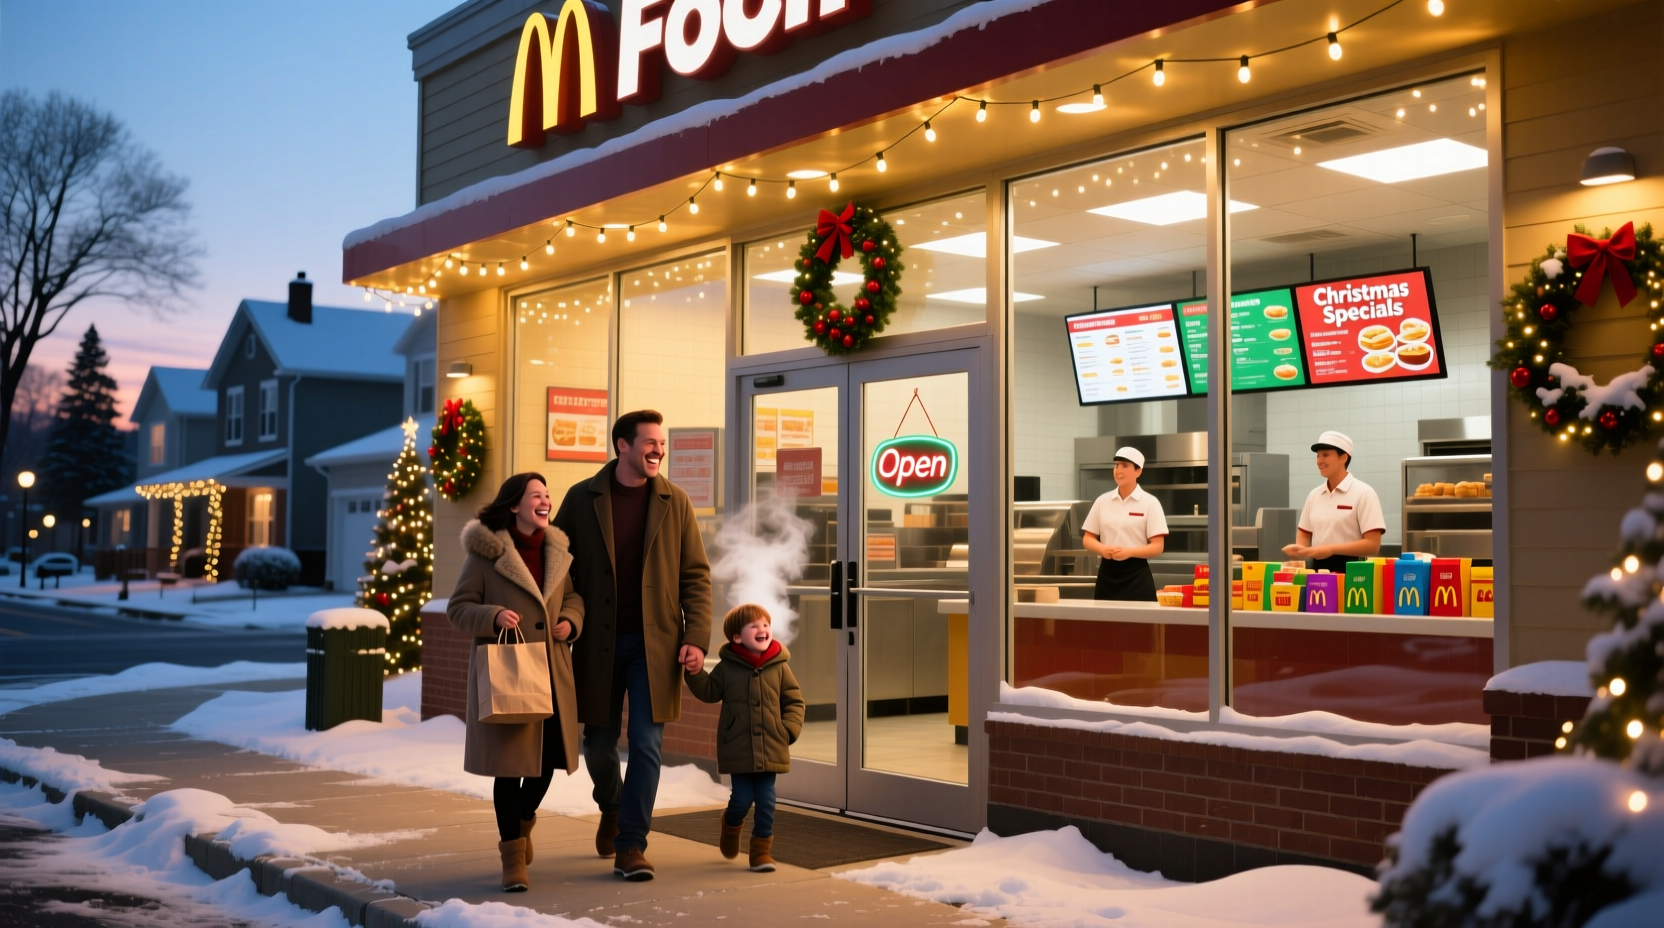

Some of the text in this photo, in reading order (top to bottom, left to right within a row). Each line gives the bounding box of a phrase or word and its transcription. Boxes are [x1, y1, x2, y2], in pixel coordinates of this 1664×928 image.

[1313, 282, 1409, 306] Christmas
[1323, 298, 1404, 327] Specials
[879, 448, 947, 487] Open
